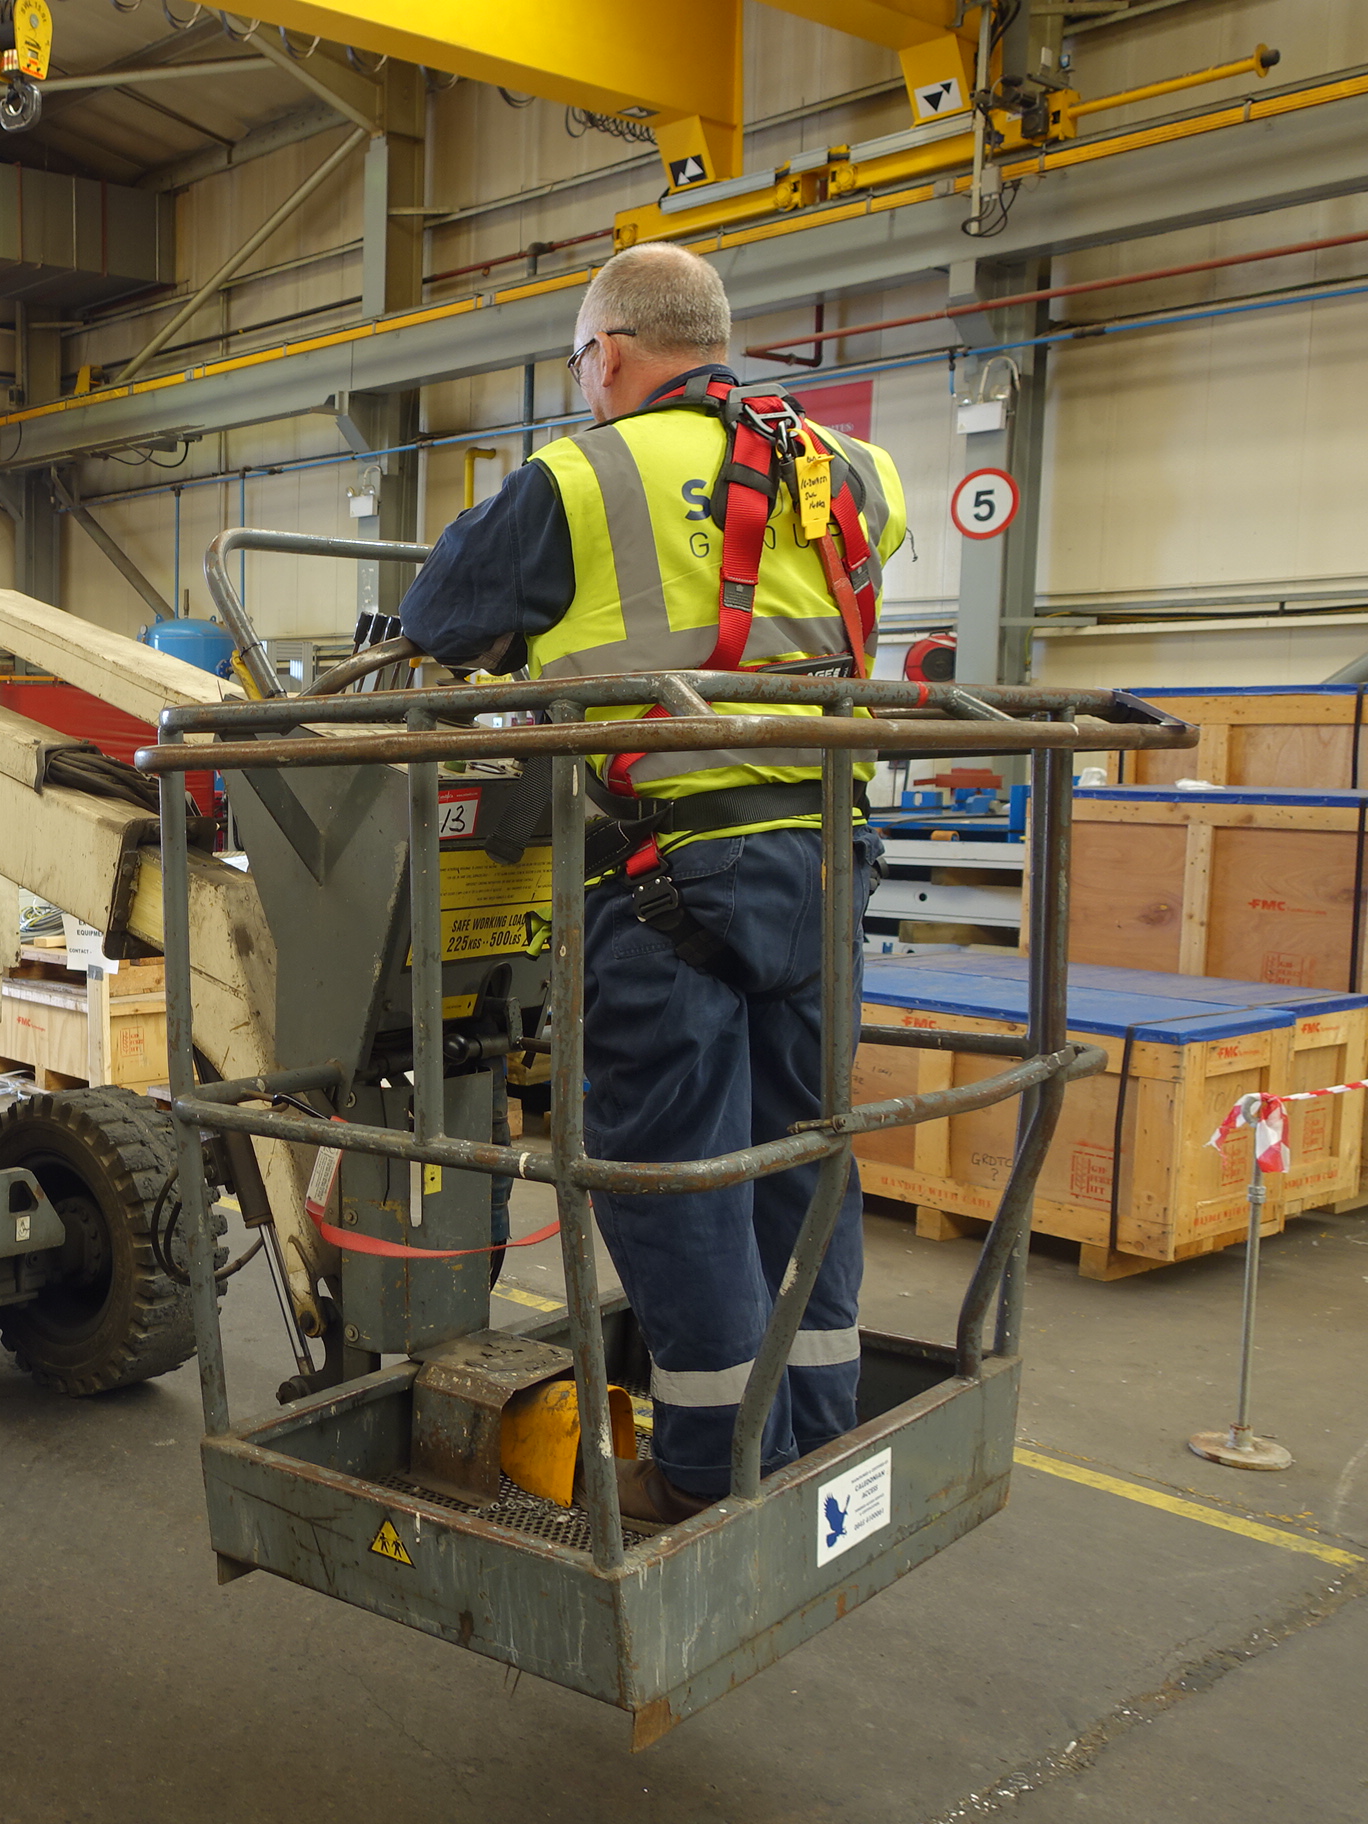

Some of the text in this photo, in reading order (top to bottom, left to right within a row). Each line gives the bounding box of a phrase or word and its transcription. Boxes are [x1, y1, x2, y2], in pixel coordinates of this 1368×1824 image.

[973, 488, 996, 522] 5
[441, 804, 466, 834] 13
[1248, 898, 1286, 911] FMC
[451, 918, 472, 932] SAFE
[472, 915, 508, 930] WORKING
[902, 1016, 937, 1029] FMC
[1301, 1022, 1321, 1034] FMC
[1217, 1046, 1239, 1059] FMC
[881, 1176, 923, 1193] HANDLE
[928, 1187, 958, 1201] WITH
